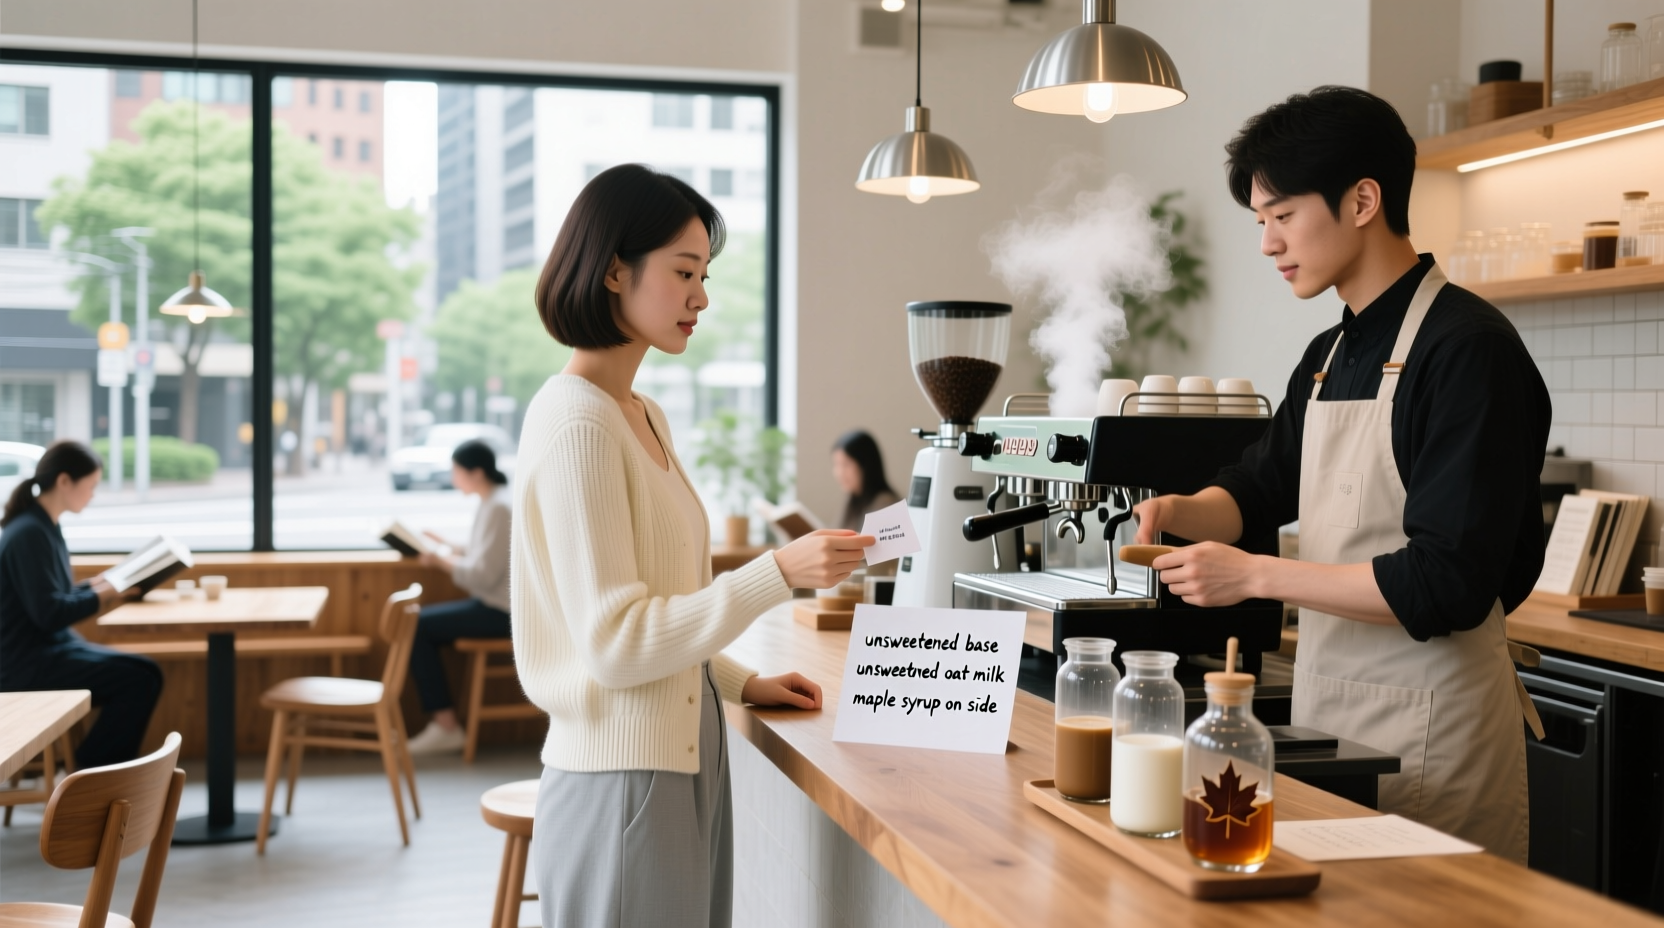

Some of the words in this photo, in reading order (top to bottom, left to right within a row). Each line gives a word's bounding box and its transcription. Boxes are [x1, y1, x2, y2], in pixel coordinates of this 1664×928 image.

[865, 632, 960, 651] unsweetened
[965, 633, 999, 654] base
[944, 664, 971, 681] oat
[972, 664, 1005, 683] milk
[852, 688, 896, 714] maple
[900, 696, 941, 717] syrup
[945, 700, 962, 712] on
[967, 694, 998, 714] side
